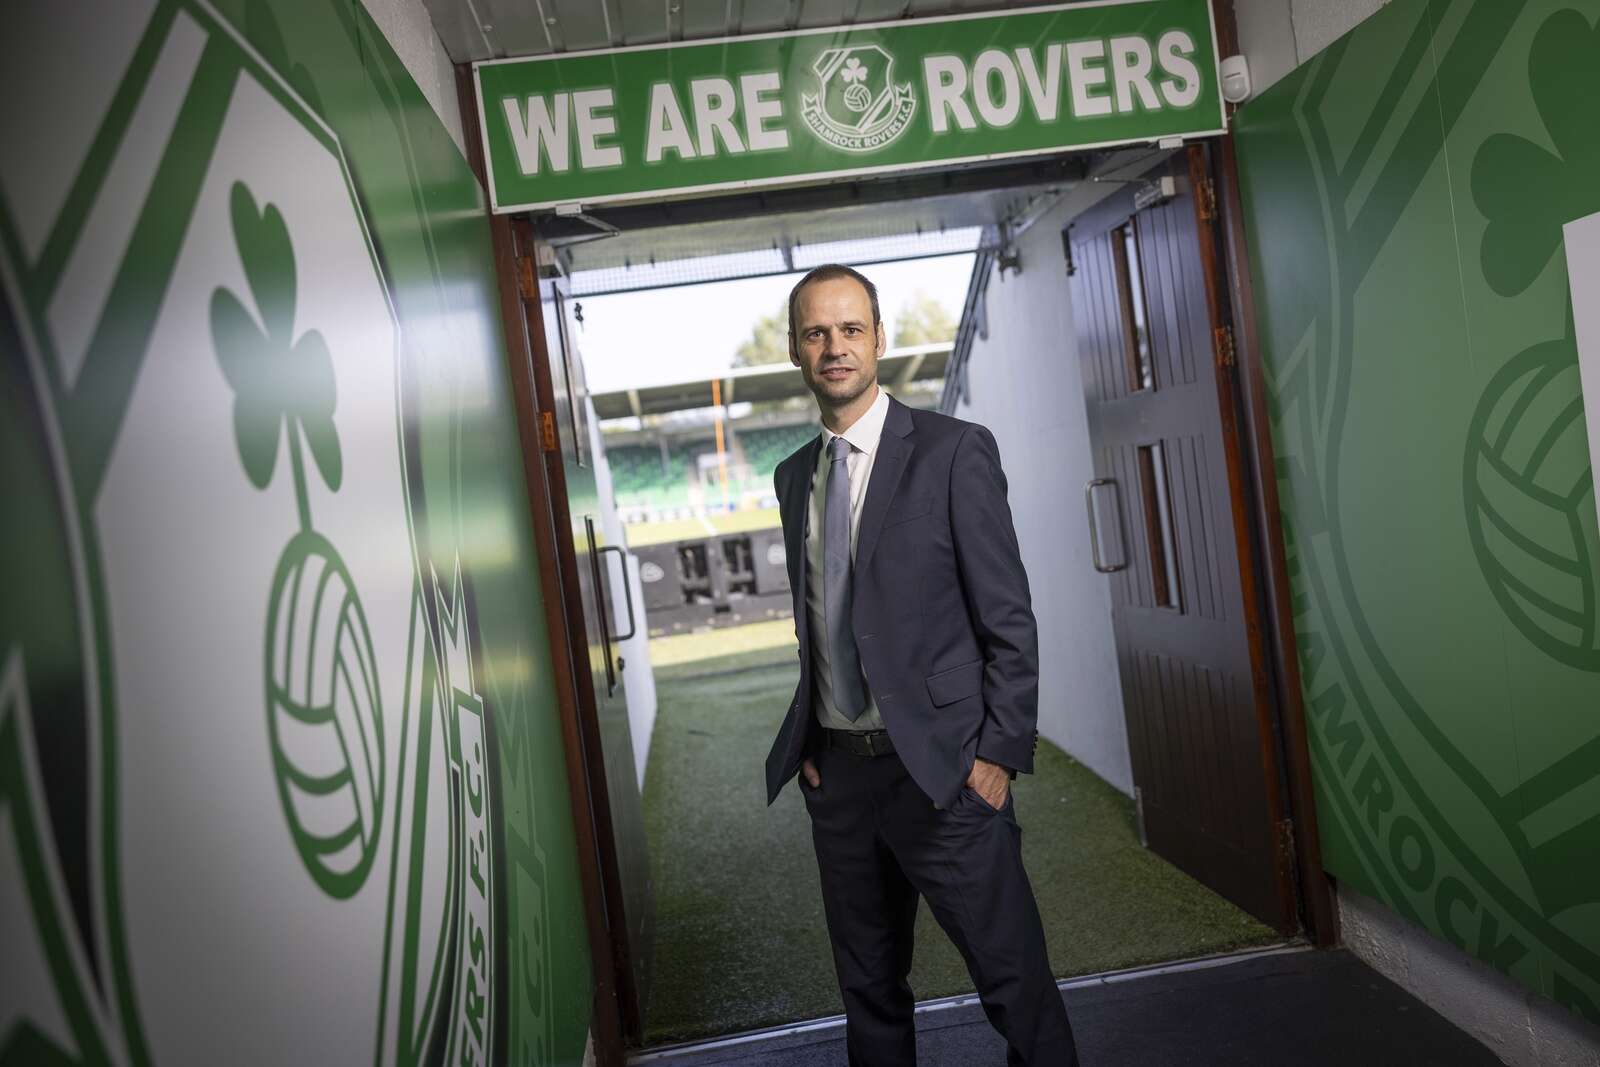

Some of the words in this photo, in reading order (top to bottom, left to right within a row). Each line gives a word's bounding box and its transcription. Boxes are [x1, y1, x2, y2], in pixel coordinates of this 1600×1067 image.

[502, 87, 624, 175] WE
[645, 71, 790, 163] ARE
[923, 31, 1201, 133] ROVERS
[807, 112, 862, 148] SHAMROCK
[863, 122, 901, 147] ROVERS
[897, 102, 912, 121] F.C.
[1281, 509, 1530, 977] AMROCK
[465, 741, 486, 900] F.C.
